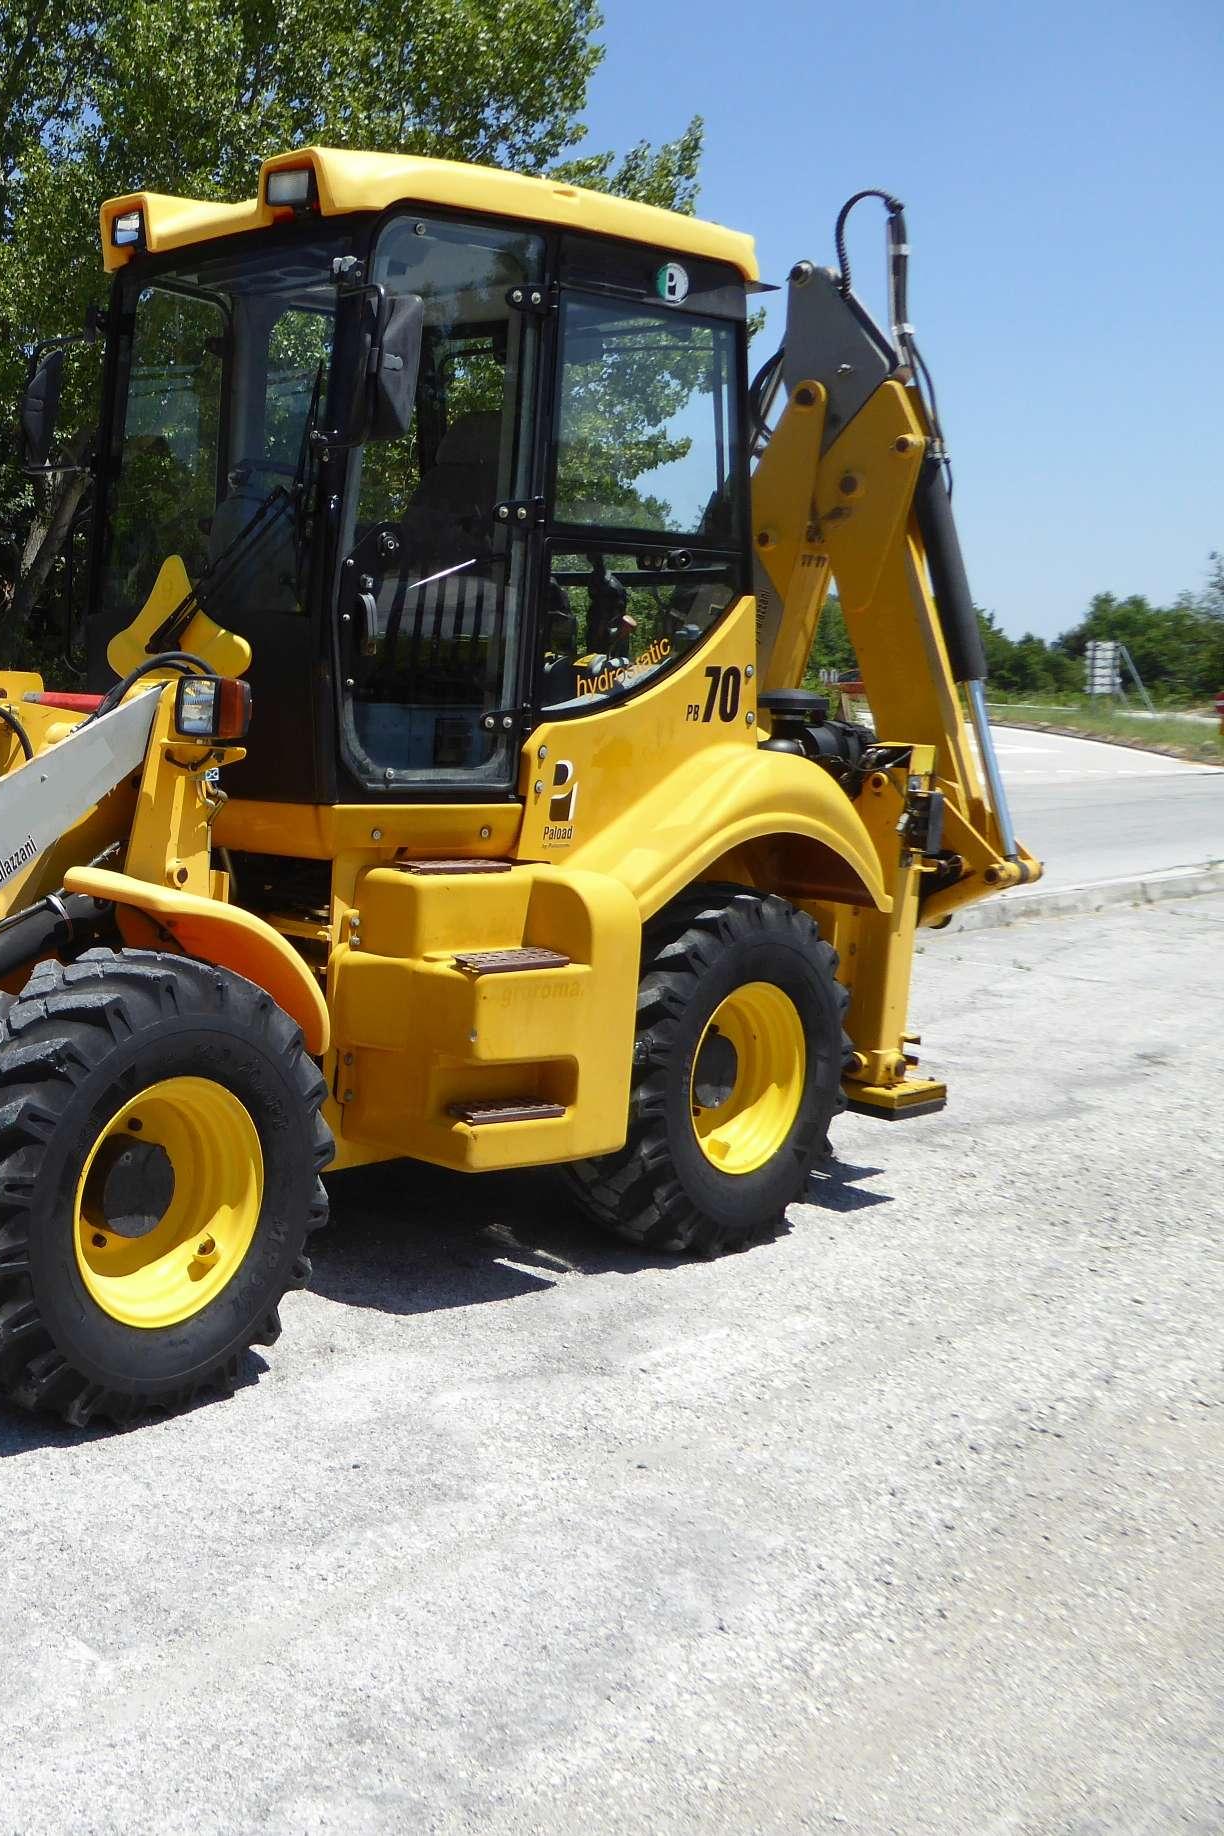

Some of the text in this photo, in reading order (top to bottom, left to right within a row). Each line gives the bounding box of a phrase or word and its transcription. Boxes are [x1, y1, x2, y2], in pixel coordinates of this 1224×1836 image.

[686, 665, 741, 723] PB 70
[543, 825, 574, 840] Paload
